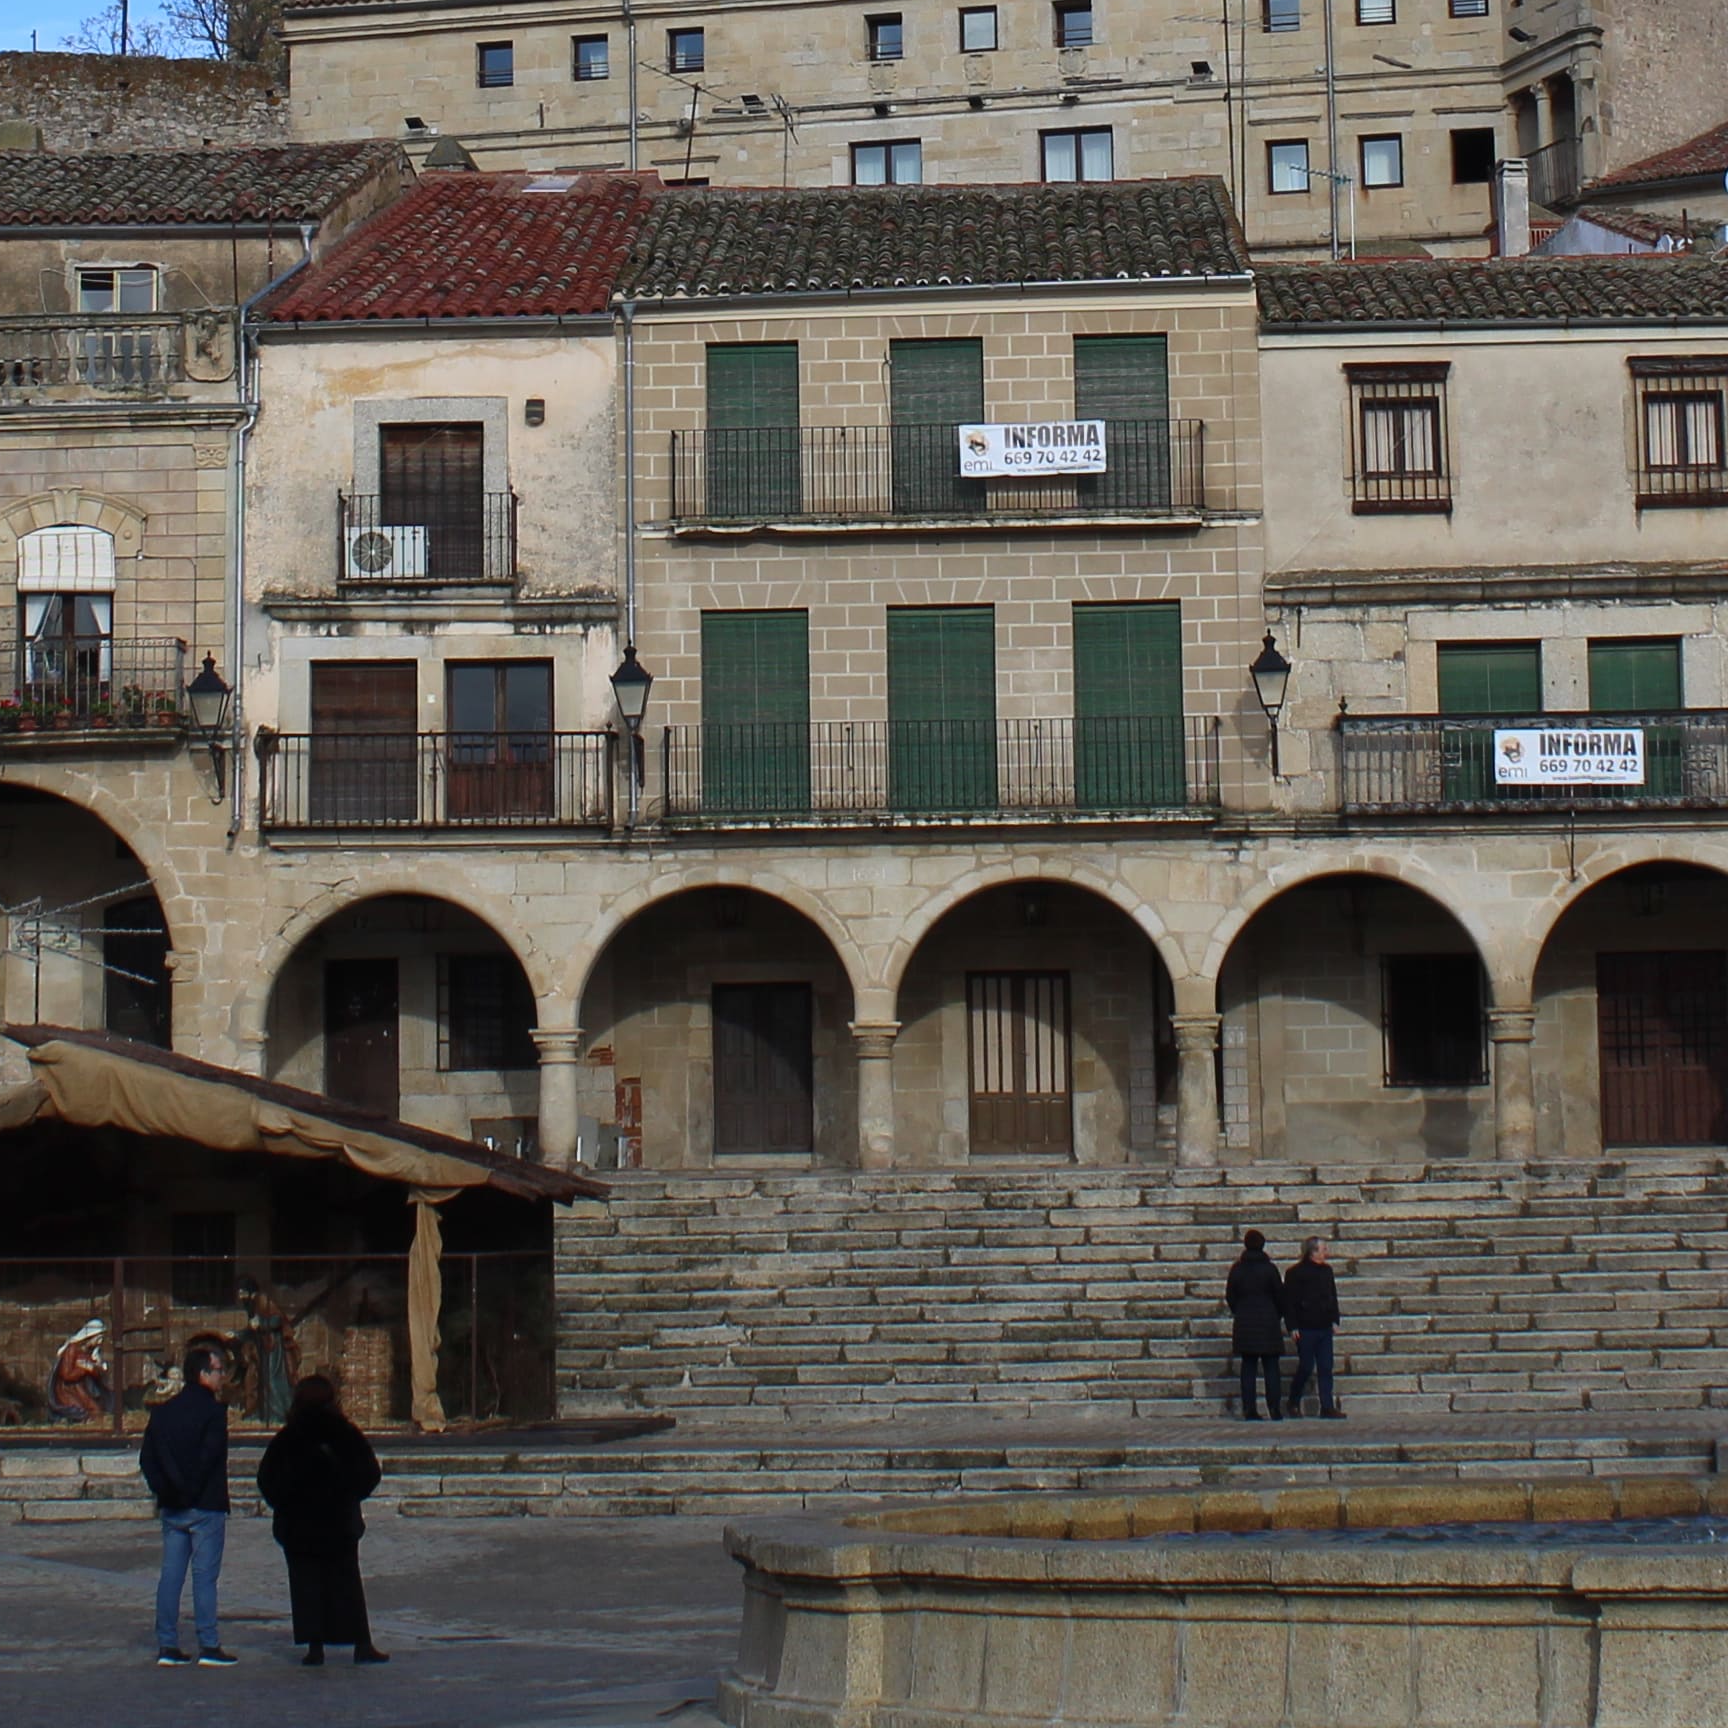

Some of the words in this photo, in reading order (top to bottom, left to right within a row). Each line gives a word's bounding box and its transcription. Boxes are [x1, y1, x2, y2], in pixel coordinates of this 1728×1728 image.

[1004, 424, 1100, 449] INFORMA
[1004, 451, 1032, 465] 669
[1037, 450, 1055, 464] 70
[1060, 450, 1078, 463] 42
[1083, 449, 1102, 462] 42
[964, 459, 993, 472] emi
[1539, 733, 1637, 756] INFORMA
[1498, 766, 1528, 778] emi
[1539, 759, 1568, 772] 669
[1573, 759, 1591, 772] 70
[1596, 759, 1615, 772] 42
[1619, 759, 1638, 772] 42
